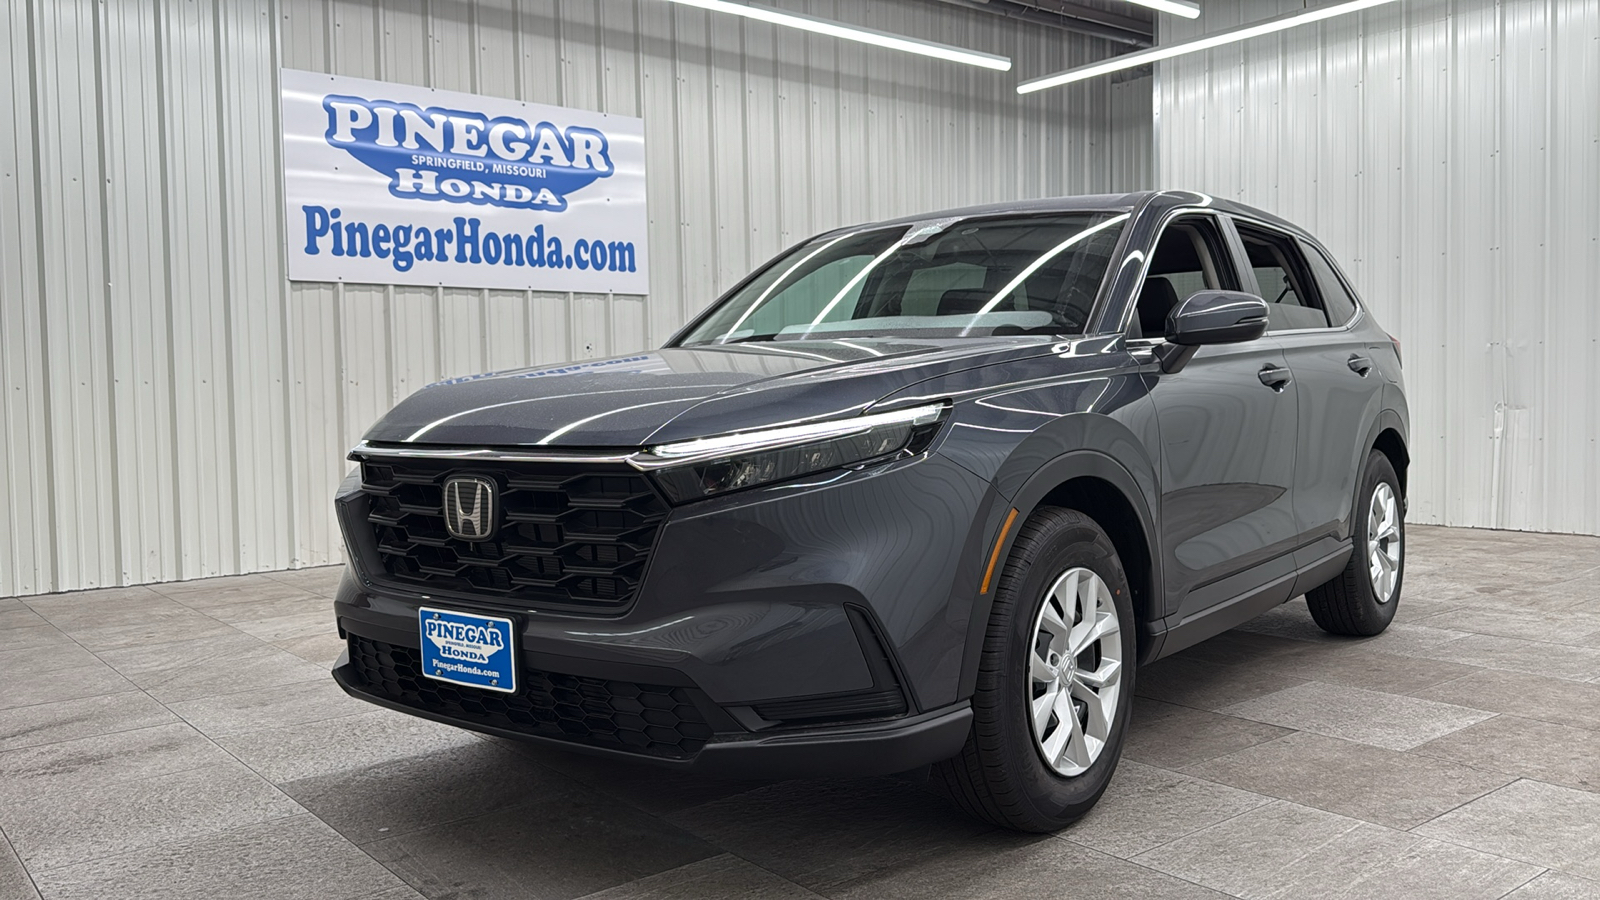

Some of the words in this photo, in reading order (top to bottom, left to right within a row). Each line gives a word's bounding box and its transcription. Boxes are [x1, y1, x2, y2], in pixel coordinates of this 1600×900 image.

[329, 101, 609, 172] PINEGAR
[411, 154, 489, 174] SPRINGFIELD,
[492, 163, 547, 179] MISSOURI
[395, 168, 562, 206] HONDA
[302, 205, 637, 273] PinegarHonda.com
[427, 621, 502, 647] PINEGAR
[441, 645, 487, 661] HONDA
[432, 658, 500, 678] PinegarHonda.com
